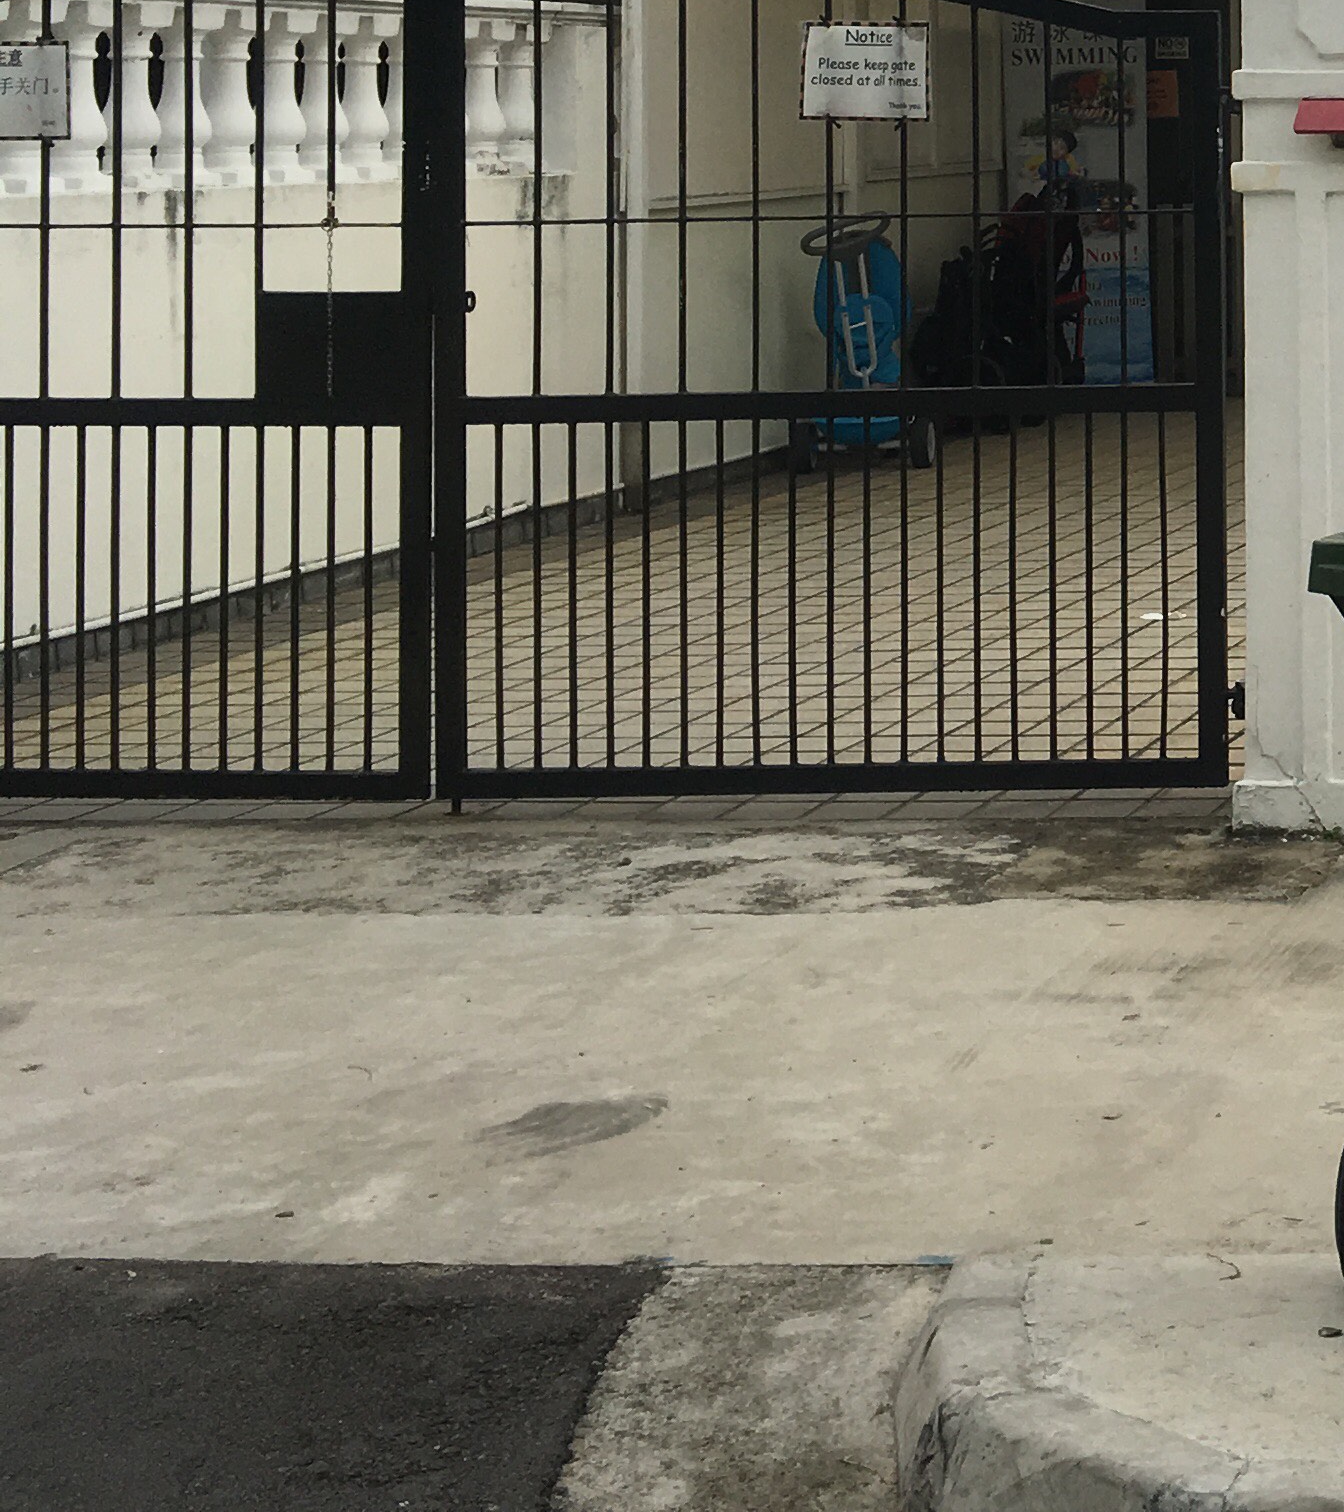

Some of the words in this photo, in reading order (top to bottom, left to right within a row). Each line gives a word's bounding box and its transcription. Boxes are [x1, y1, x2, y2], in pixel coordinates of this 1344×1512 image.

[845, 29, 893, 44] Notice
[1011, 46, 1137, 66] SWMMING
[818, 57, 860, 70] Please
[864, 58, 888, 73] keep
[891, 61, 916, 74] gate
[810, 74, 853, 86] closed
[857, 76, 871, 86] at
[874, 75, 885, 87] all
[888, 76, 921, 87] times.
